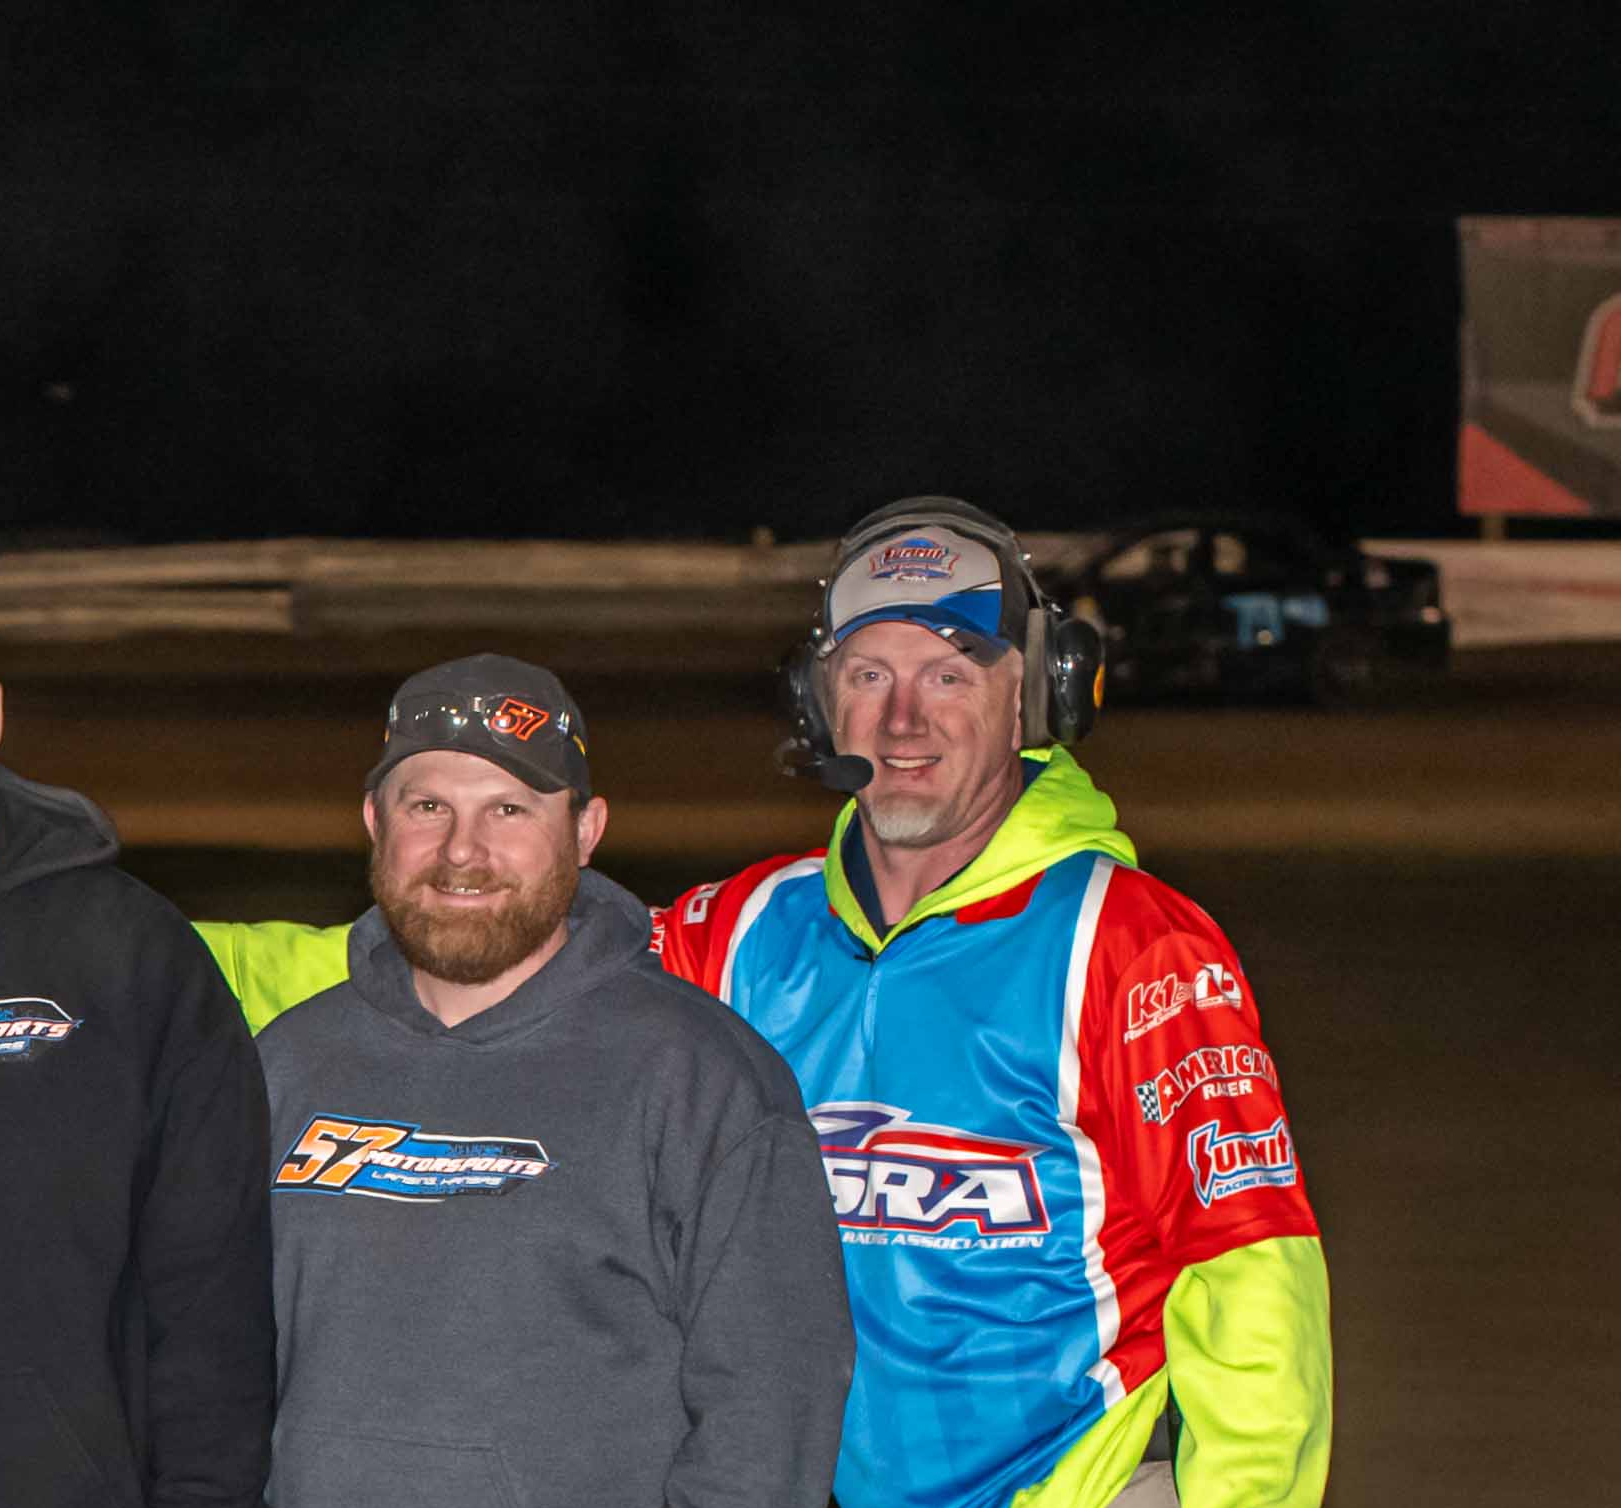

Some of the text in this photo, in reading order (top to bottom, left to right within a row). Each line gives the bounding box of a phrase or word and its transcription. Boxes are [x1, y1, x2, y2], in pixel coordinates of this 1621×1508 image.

[275, 1119, 409, 1187] 57
[360, 1150, 549, 1176] MOTORSPORTS
[890, 1233, 1045, 1250] ASSOCIATION
